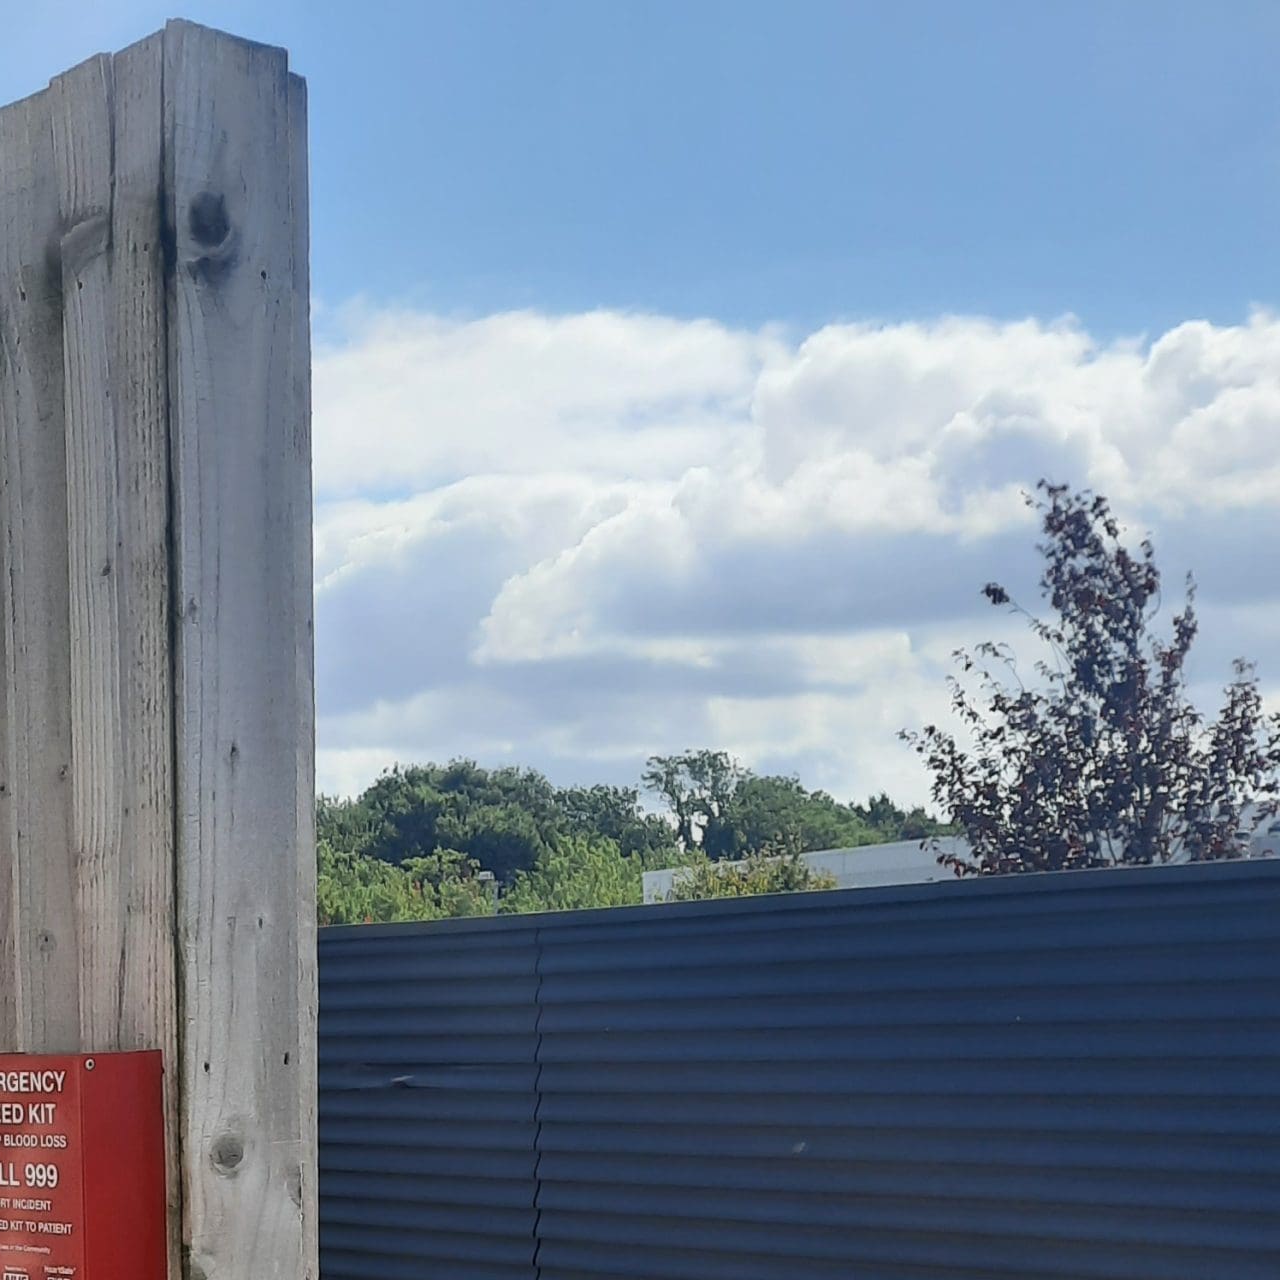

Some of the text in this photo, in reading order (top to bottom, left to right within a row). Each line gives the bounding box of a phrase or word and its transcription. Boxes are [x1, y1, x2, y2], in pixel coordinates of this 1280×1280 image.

[28, 1103, 57, 1124] KIT
[3, 1134, 38, 1148] BLOOD
[40, 1135, 67, 1148] LOSS
[24, 1162, 59, 1188] 999
[12, 1198, 52, 1211] INCIDENT
[10, 1220, 24, 1231] KIT
[25, 1221, 37, 1232] TO
[38, 1222, 73, 1235] PATIENT
